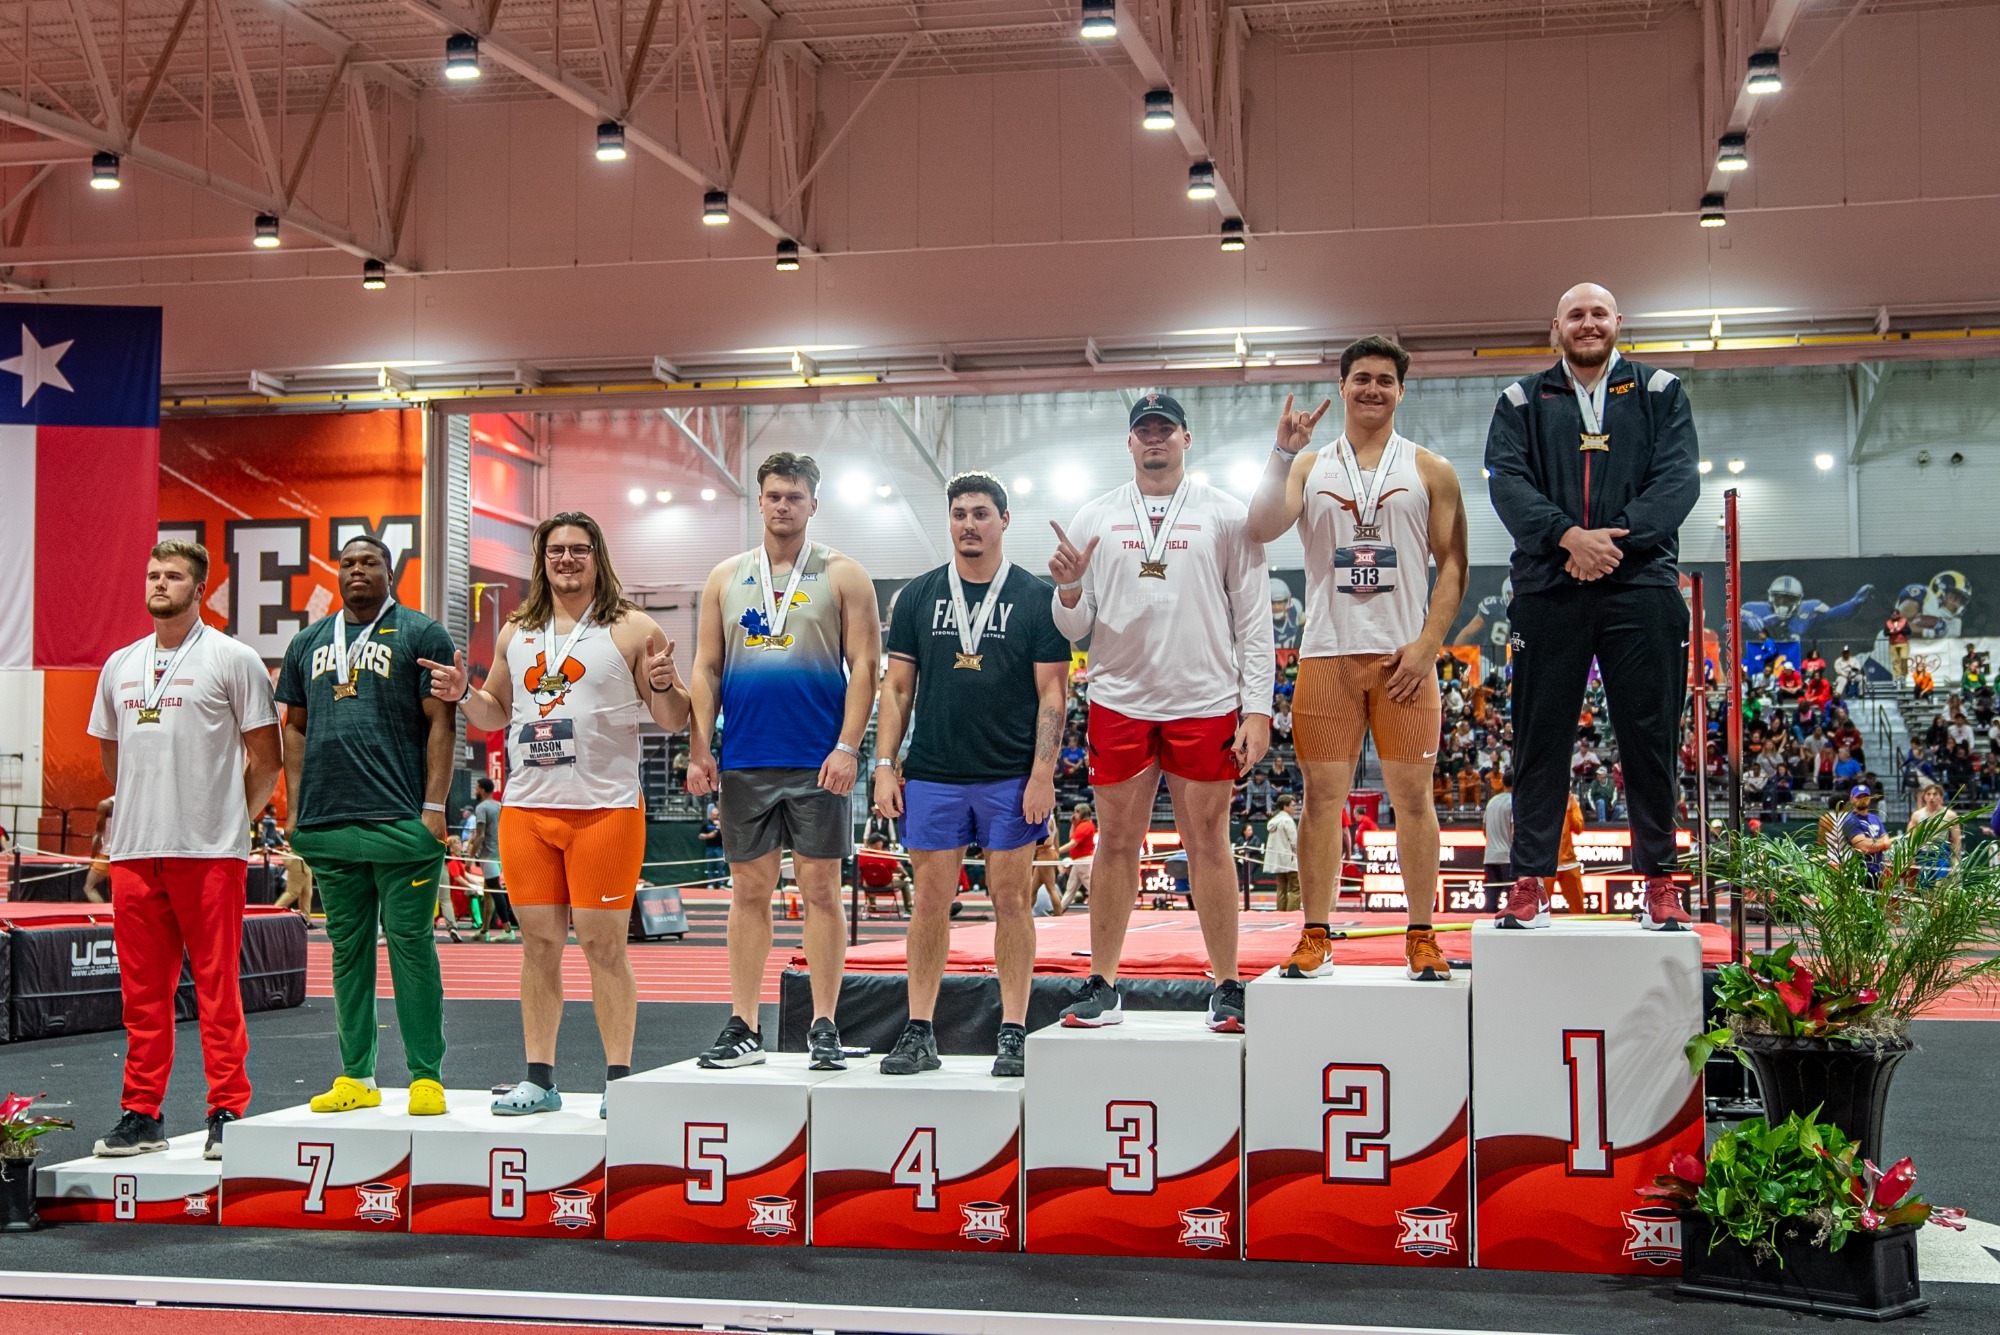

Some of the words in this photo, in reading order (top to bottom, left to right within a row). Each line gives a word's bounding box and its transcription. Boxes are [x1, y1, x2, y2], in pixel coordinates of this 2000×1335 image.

[1122, 541, 1146, 550] TRAC
[1351, 567, 1380, 586] 513
[124, 699, 146, 710] TRAC
[529, 740, 562, 754] MASON
[1322, 1062, 1391, 1187] 2
[1562, 1029, 1614, 1178] 1
[298, 1142, 334, 1214] 7
[684, 1122, 728, 1206] 5
[890, 1127, 940, 1212] 4
[1106, 1100, 1158, 1196] 3
[114, 1174, 137, 1220] 8
[489, 1148, 527, 1221] 6
